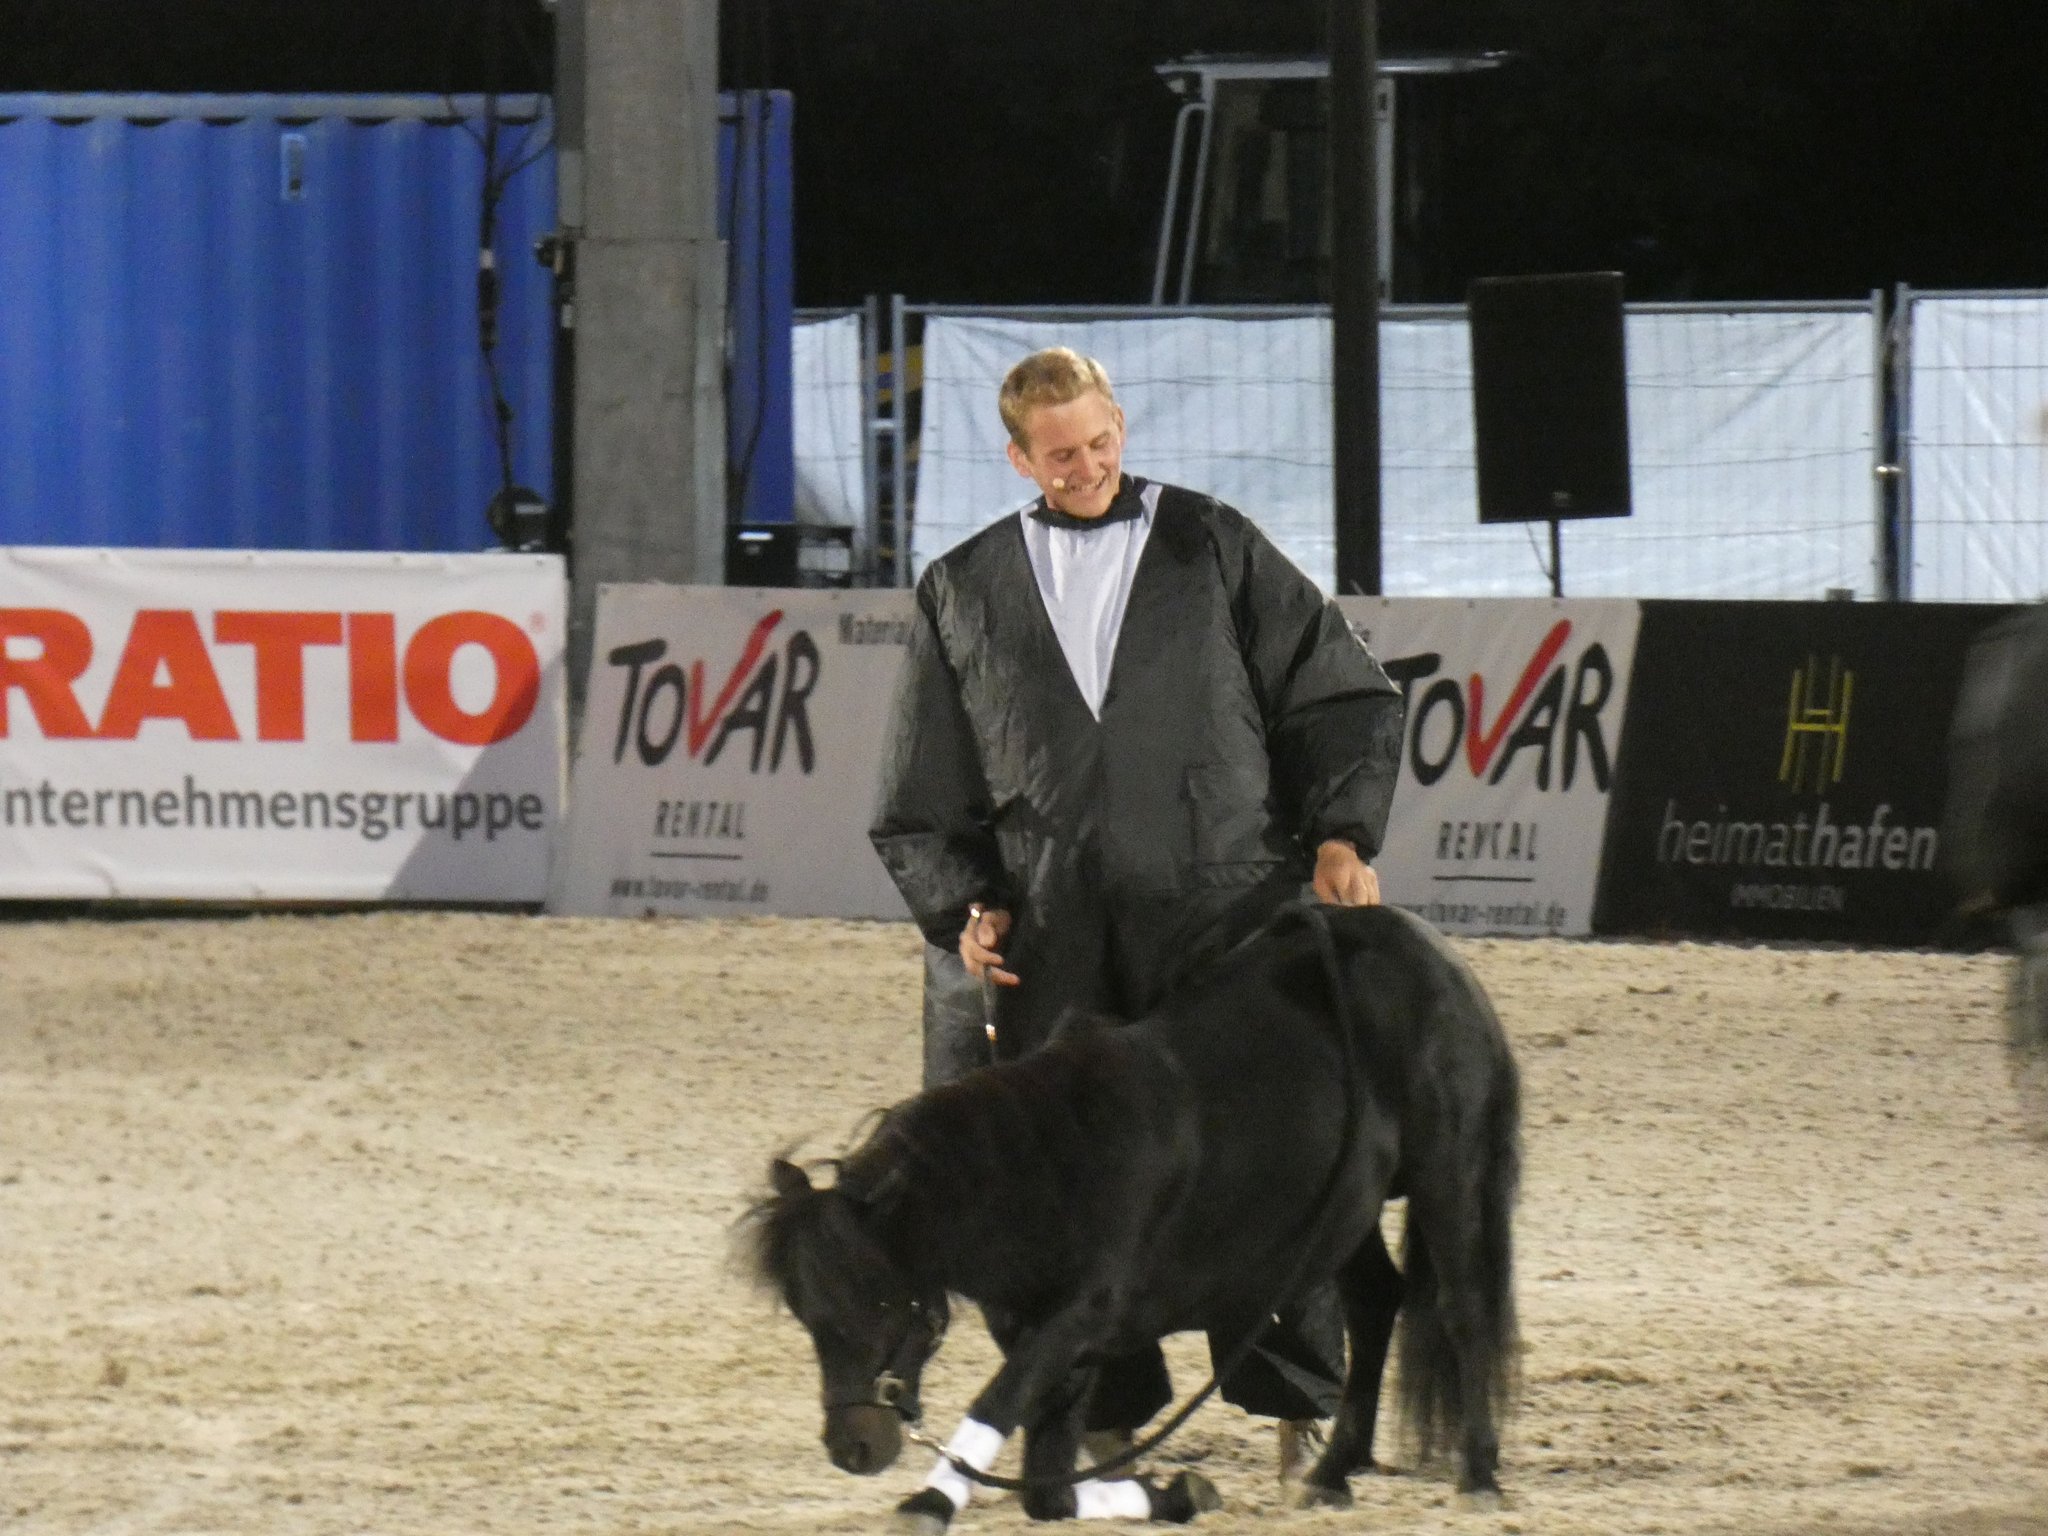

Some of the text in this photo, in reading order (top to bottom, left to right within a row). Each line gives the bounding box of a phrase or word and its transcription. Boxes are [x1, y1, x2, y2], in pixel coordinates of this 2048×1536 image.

[0, 608, 541, 746] RATIO
[609, 608, 818, 775] TOVAR
[1381, 618, 1613, 793] TOVAR
[4, 775, 543, 840] nternehmensgruppe
[655, 800, 744, 840] RENTAL
[1656, 800, 1938, 870] heimathafen
